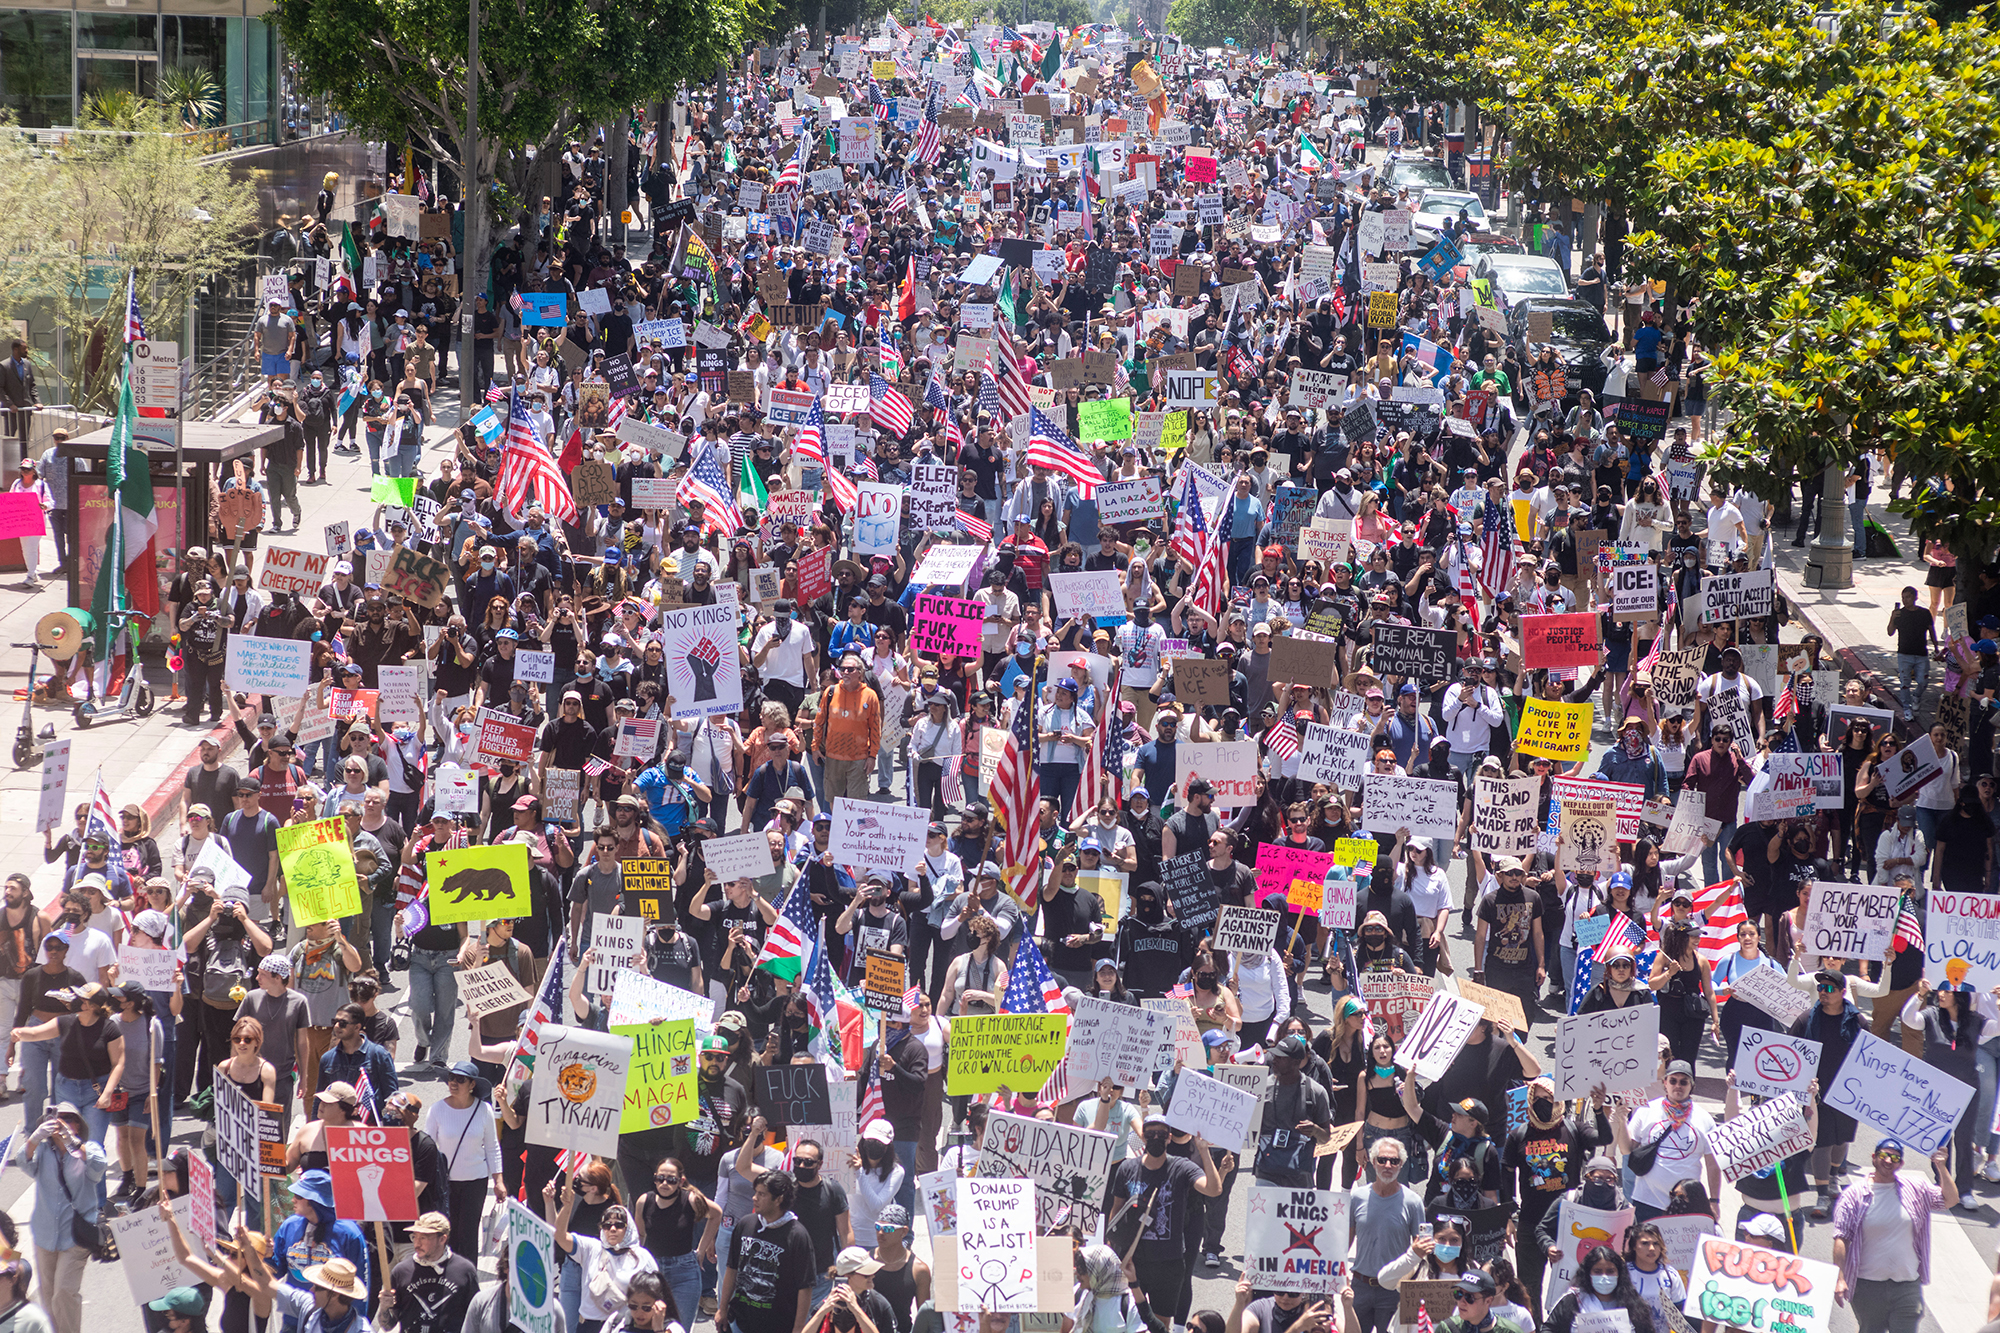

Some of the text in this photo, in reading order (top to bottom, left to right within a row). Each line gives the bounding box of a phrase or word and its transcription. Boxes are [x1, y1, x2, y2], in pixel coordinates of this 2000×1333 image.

[1160, 55, 1183, 65] FUCK
[1161, 64, 1179, 74] ICE
[1011, 115, 1027, 123] ALL
[1013, 130, 1038, 138] PEOPLE
[846, 142, 862, 151] NOT
[844, 151, 870, 159] KING
[1202, 214, 1222, 224] NOW!
[822, 223, 833, 231] OUT
[1152, 244, 1171, 255] NOW!
[1370, 310, 1397, 318] GLOBAL
[1370, 316, 1395, 325] WAR!
[152, 356, 175, 364] Metro
[135, 367, 145, 375] 16
[608, 364, 628, 375] KINGS
[613, 372, 629, 382] JUST
[135, 376, 145, 384] 18
[135, 386, 145, 394] 20
[614, 385, 640, 398] QUEENS
[135, 396, 145, 404] 53
[1098, 482, 1135, 494] DIGNITY
[1121, 494, 1146, 504] RAZA
[1100, 508, 1139, 520] ESTAMOS
[1303, 530, 1347, 541] FOR THOSE
[1304, 539, 1333, 548] WITHOUT
[1308, 547, 1338, 559] VOICE
[266, 549, 328, 575] NOT MY
[260, 570, 321, 598] CHEETOH!
[1617, 570, 1654, 590] ICE:
[1708, 577, 1741, 592] MEN OF
[1707, 587, 1770, 607] QUALITY ACCEPT
[919, 598, 985, 620] FUCK ICE
[666, 606, 732, 629] NO KINGS
[918, 619, 957, 640] FUCK
[1547, 627, 1584, 635] JUSTICE
[1376, 627, 1442, 648] THE REAL
[1546, 636, 1581, 644] PEOPLE
[914, 636, 978, 656] TRUMP!!
[1376, 644, 1430, 662] CRIMINAL
[521, 671, 547, 679] MIGRA
[1175, 665, 1210, 679] FUCK
[1658, 665, 1683, 679] THE
[1182, 680, 1206, 694] ICE
[1652, 676, 1694, 694] GRIND
[706, 703, 740, 714] #HANDSOFF
[1527, 706, 1560, 719] PROUD
[485, 723, 505, 735] KEEP
[1537, 719, 1559, 729] LIVE
[482, 732, 518, 746] FAMILIES
[1308, 725, 1370, 750] IMMIGRANTS
[1537, 730, 1562, 739] CITY
[481, 741, 522, 757] TOGETHER!
[1518, 737, 1580, 752] IMMIGRANTS
[1302, 751, 1355, 771] AMERICA
[1796, 755, 1842, 777] SASHAY
[1480, 779, 1509, 794] THIS
[1492, 791, 1530, 806] LAND
[1477, 804, 1506, 819] WAS
[1476, 817, 1534, 832] MADE FOR
[315, 819, 344, 846] ICE
[1477, 832, 1499, 849] YOU
[623, 861, 656, 872] ICE OUT
[856, 853, 904, 869] TYRANNY!
[626, 878, 668, 889] OUR HOME
[297, 882, 356, 920] MELT
[1327, 886, 1354, 906] CHINGA
[1820, 890, 1898, 919] REMEMBER
[1931, 894, 1955, 914] NO
[1224, 907, 1279, 923] AMERICANS
[1324, 910, 1352, 926] MIGRA
[1833, 914, 1858, 929] YOUR
[606, 918, 623, 930] NO
[1221, 921, 1273, 936] AGAINST
[595, 935, 634, 950] KINGS
[1134, 936, 1178, 953] MEXICO
[1220, 932, 1273, 952] TYRANNY
[1815, 929, 1867, 954] OATH
[464, 970, 494, 985] SMALL
[869, 972, 901, 985] Fascist
[872, 965, 899, 977] Trump
[868, 981, 901, 993] Regime
[1368, 975, 1431, 985] MAIN EVENT
[463, 977, 514, 1000] DICKTATOR
[866, 991, 888, 1000] MUST
[1363, 983, 1386, 993] BATTLE
[476, 992, 516, 1012] ENERGY
[954, 1017, 1045, 1034] ALL OUTRAGE
[540, 1028, 623, 1075] Tangerine
[950, 1049, 1012, 1061] PUT DOWN THE
[1742, 1032, 1819, 1066] NO KINGS
[1855, 1035, 1929, 1090] Kings have
[634, 1061, 666, 1083] TU
[1218, 1068, 1260, 1086] Trump
[766, 1068, 820, 1100] FUCK
[1184, 1074, 1244, 1106] GRAB HIM
[216, 1073, 256, 1133] POWER
[623, 1081, 688, 1110] MAGA
[1210, 1097, 1236, 1113] THE
[538, 1097, 619, 1131] TYRANT
[774, 1101, 808, 1125] ICE
[1173, 1100, 1244, 1139] CATHETER
[1833, 1078, 1943, 1151] Since 1776
[233, 1120, 255, 1164] THE
[349, 1130, 386, 1145] NO
[987, 1118, 1115, 1175] SOLIDARITY
[330, 1147, 410, 1163] KINGS
[218, 1133, 258, 1198] PEOPLE
[1028, 1158, 1062, 1179] HAS
[970, 1182, 1022, 1195] DONALD
[973, 1198, 1019, 1211] TRUMP
[1291, 1191, 1315, 1206] NO
[1277, 1203, 1328, 1222] KINGS
[983, 1218, 996, 1229] IS
[1259, 1257, 1346, 1277] IN AMERICA
[1702, 1240, 1813, 1297] FUCK
[1771, 1298, 1815, 1318] CHINGA
